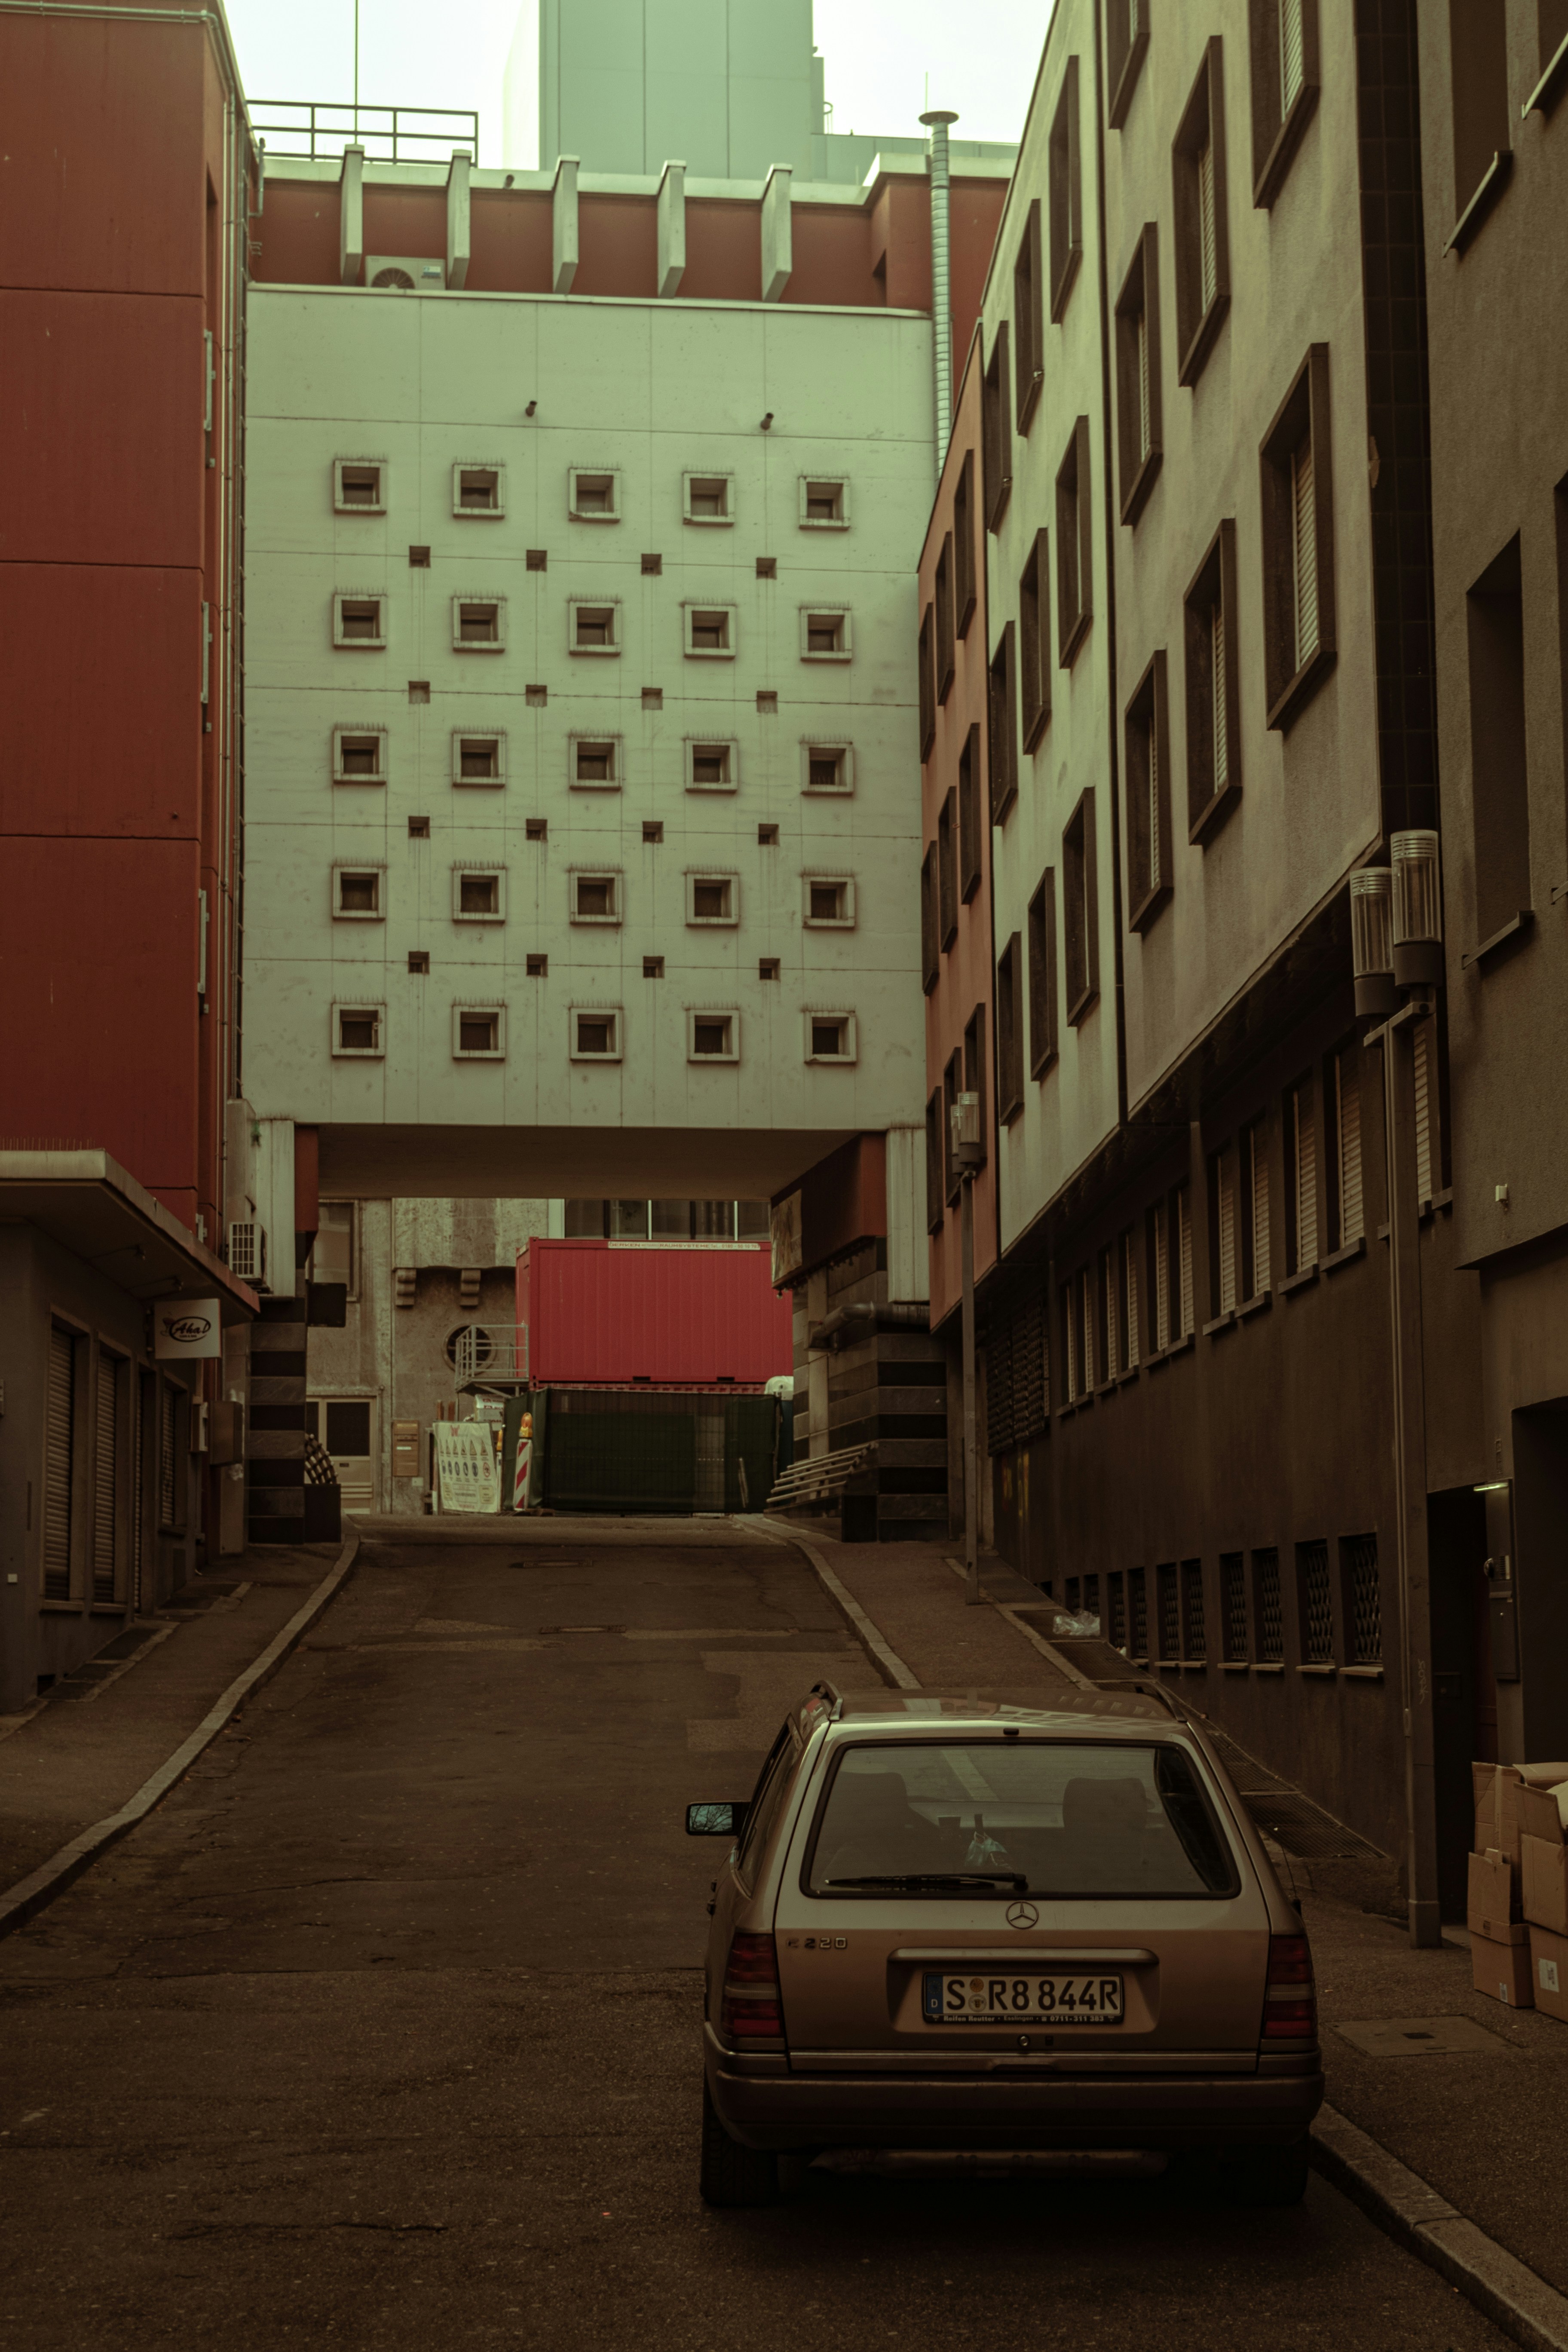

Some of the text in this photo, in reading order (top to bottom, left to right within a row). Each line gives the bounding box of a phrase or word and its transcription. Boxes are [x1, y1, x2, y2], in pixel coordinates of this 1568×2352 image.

[805, 1937, 847, 1949] 220
[946, 1980, 965, 2010] S
[931, 1999, 938, 2008] D
